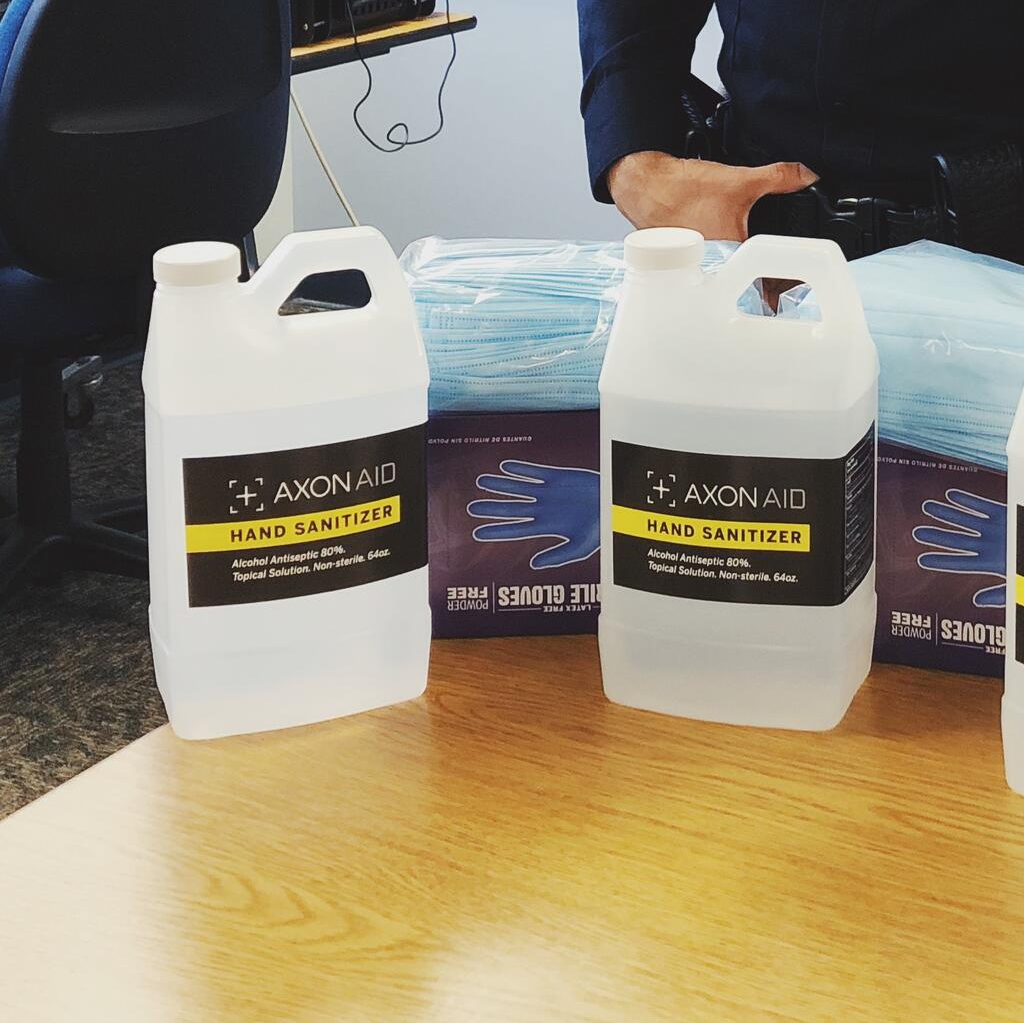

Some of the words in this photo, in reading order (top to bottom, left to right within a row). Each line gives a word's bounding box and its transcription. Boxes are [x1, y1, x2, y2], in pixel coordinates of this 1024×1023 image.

[274, 471, 351, 504] AXON
[355, 462, 396, 491] AID
[684, 483, 758, 508] AXON
[762, 488, 806, 510] AID
[230, 525, 286, 543] HAND
[294, 504, 393, 536] SANITIZER
[647, 519, 695, 538] HAND
[702, 526, 802, 544] SANITIZER
[231, 557, 268, 569] Alcohol
[270, 550, 319, 567] Antiseptic
[321, 545, 346, 559] 80%.
[232, 569, 267, 582] Topical
[268, 564, 311, 578] Solution.
[313, 554, 365, 572] Non-sterile.
[367, 547, 391, 561] 64oz.
[647, 548, 679, 562] Alcohol
[680, 552, 725, 567] Antiseptic
[726, 557, 751, 568] 80%.
[648, 561, 677, 576] Topical
[678, 566, 717, 579] Solution.
[719, 570, 771, 582] Non-sterile.
[773, 572, 799, 583] 64oz.
[447, 586, 488, 600] FREE
[498, 585, 565, 607] GLOVES
[447, 598, 489, 611] POWDER
[543, 605, 563, 613] FREE
[566, 604, 592, 612] LATEX
[891, 611, 931, 628] FREE
[891, 624, 932, 641] POWDER
[941, 618, 1006, 644] GLOVES
